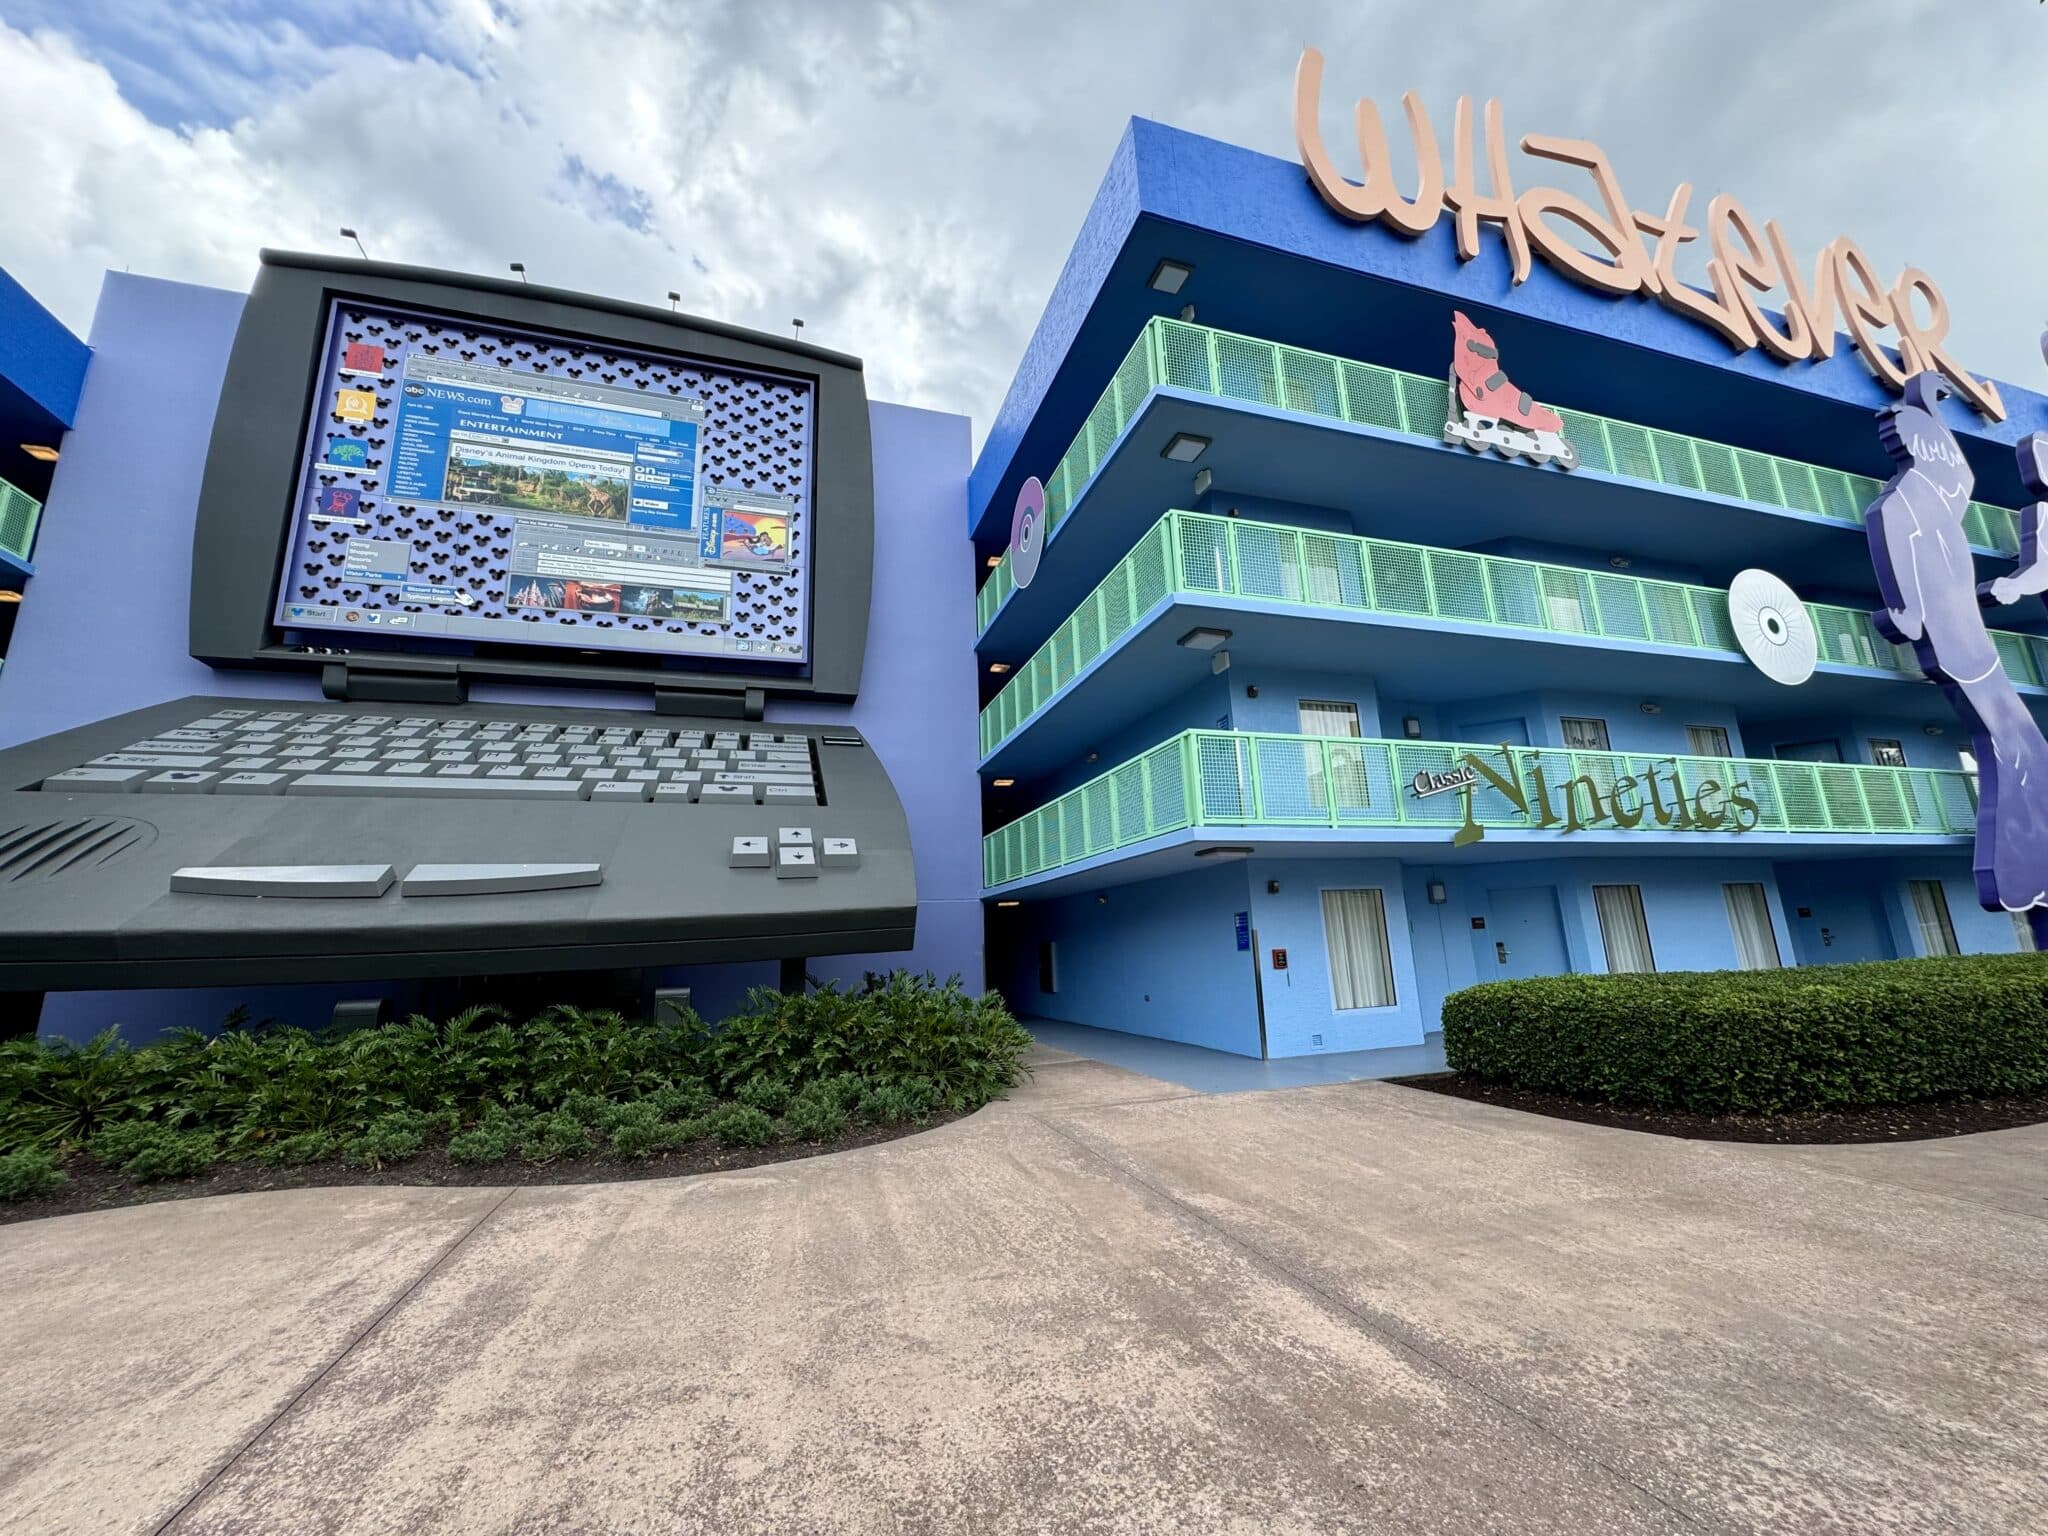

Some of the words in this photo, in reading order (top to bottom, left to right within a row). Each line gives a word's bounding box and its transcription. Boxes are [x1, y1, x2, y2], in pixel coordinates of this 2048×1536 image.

[405, 386, 425, 397] abc
[426, 388, 492, 406] NEWS.com
[460, 419, 564, 440] ENTERTAINMENT
[455, 445, 494, 458] Disney's
[495, 451, 526, 461] Animal
[527, 456, 567, 468] Kingdom
[568, 460, 597, 471] Opens
[598, 464, 626, 475] Today!
[1413, 765, 1476, 794] Classic
[1454, 741, 1760, 848] Nineties
